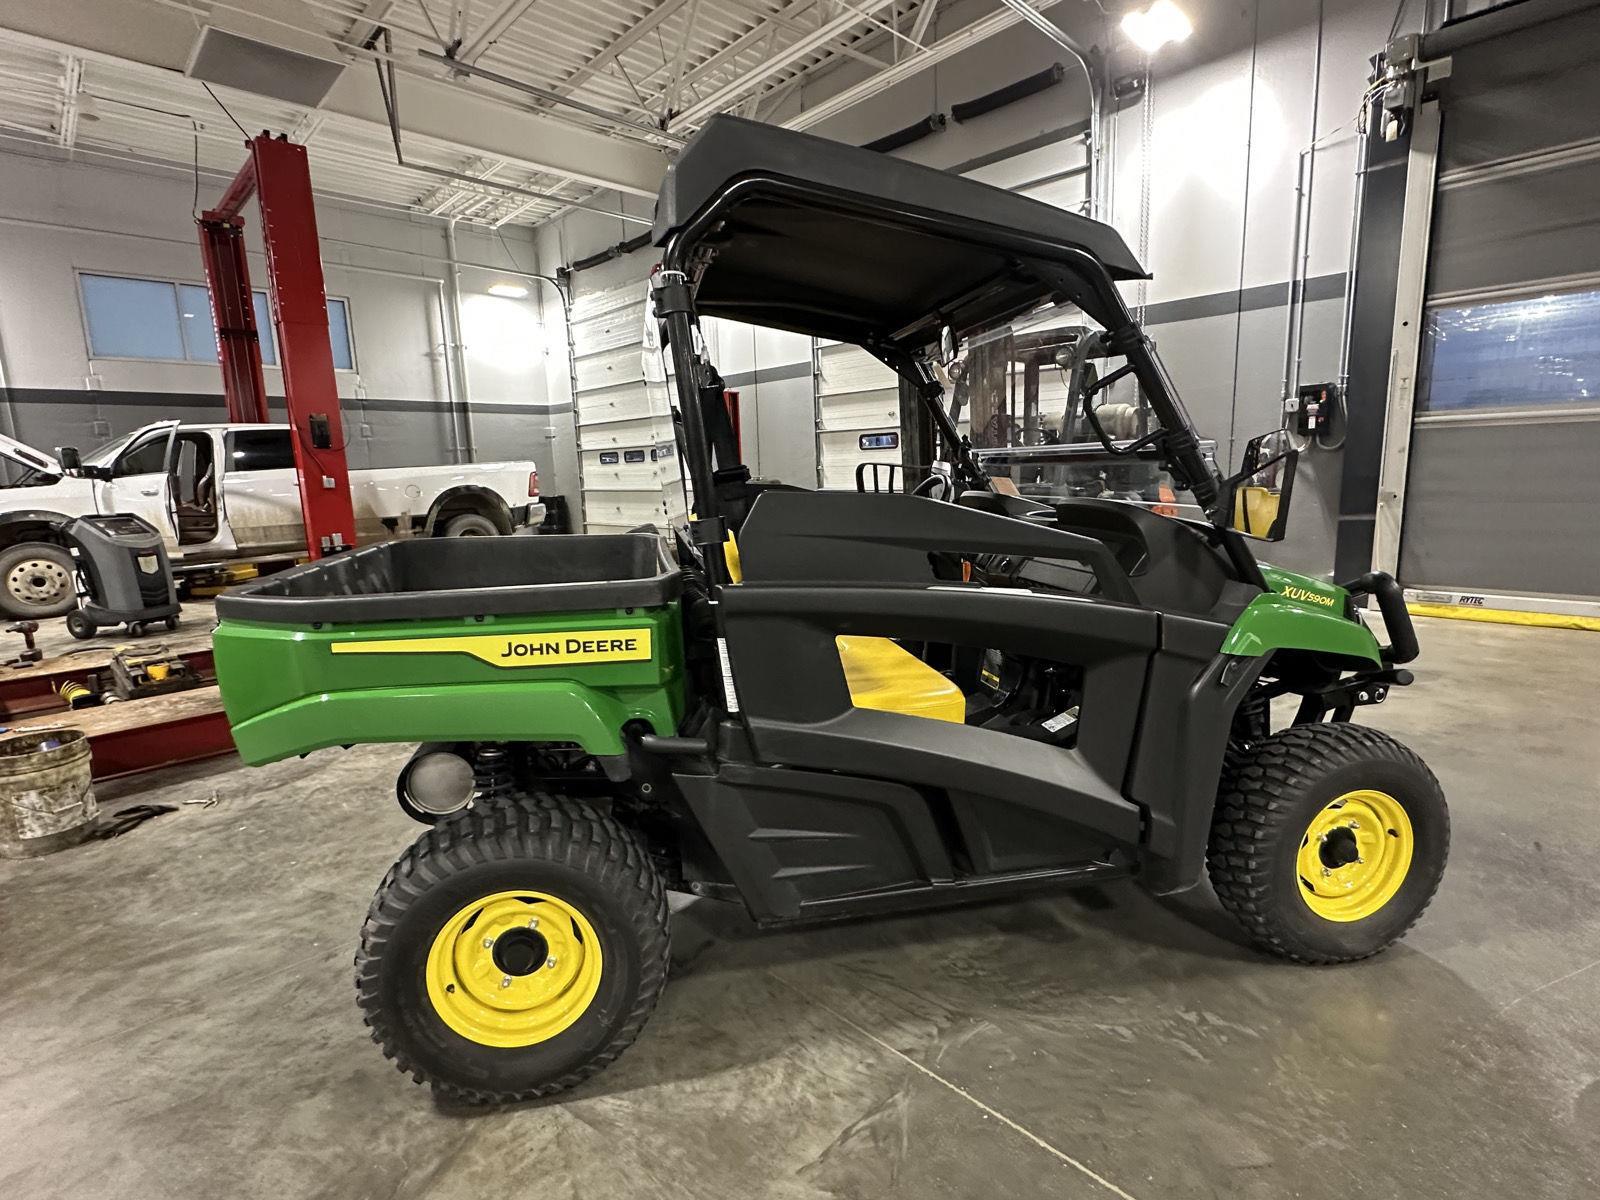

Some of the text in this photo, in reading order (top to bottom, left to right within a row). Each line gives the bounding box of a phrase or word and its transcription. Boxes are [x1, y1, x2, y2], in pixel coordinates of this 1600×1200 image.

[1459, 595, 1485, 605] RYTEC
[501, 638, 637, 658] JOHN DEERE
